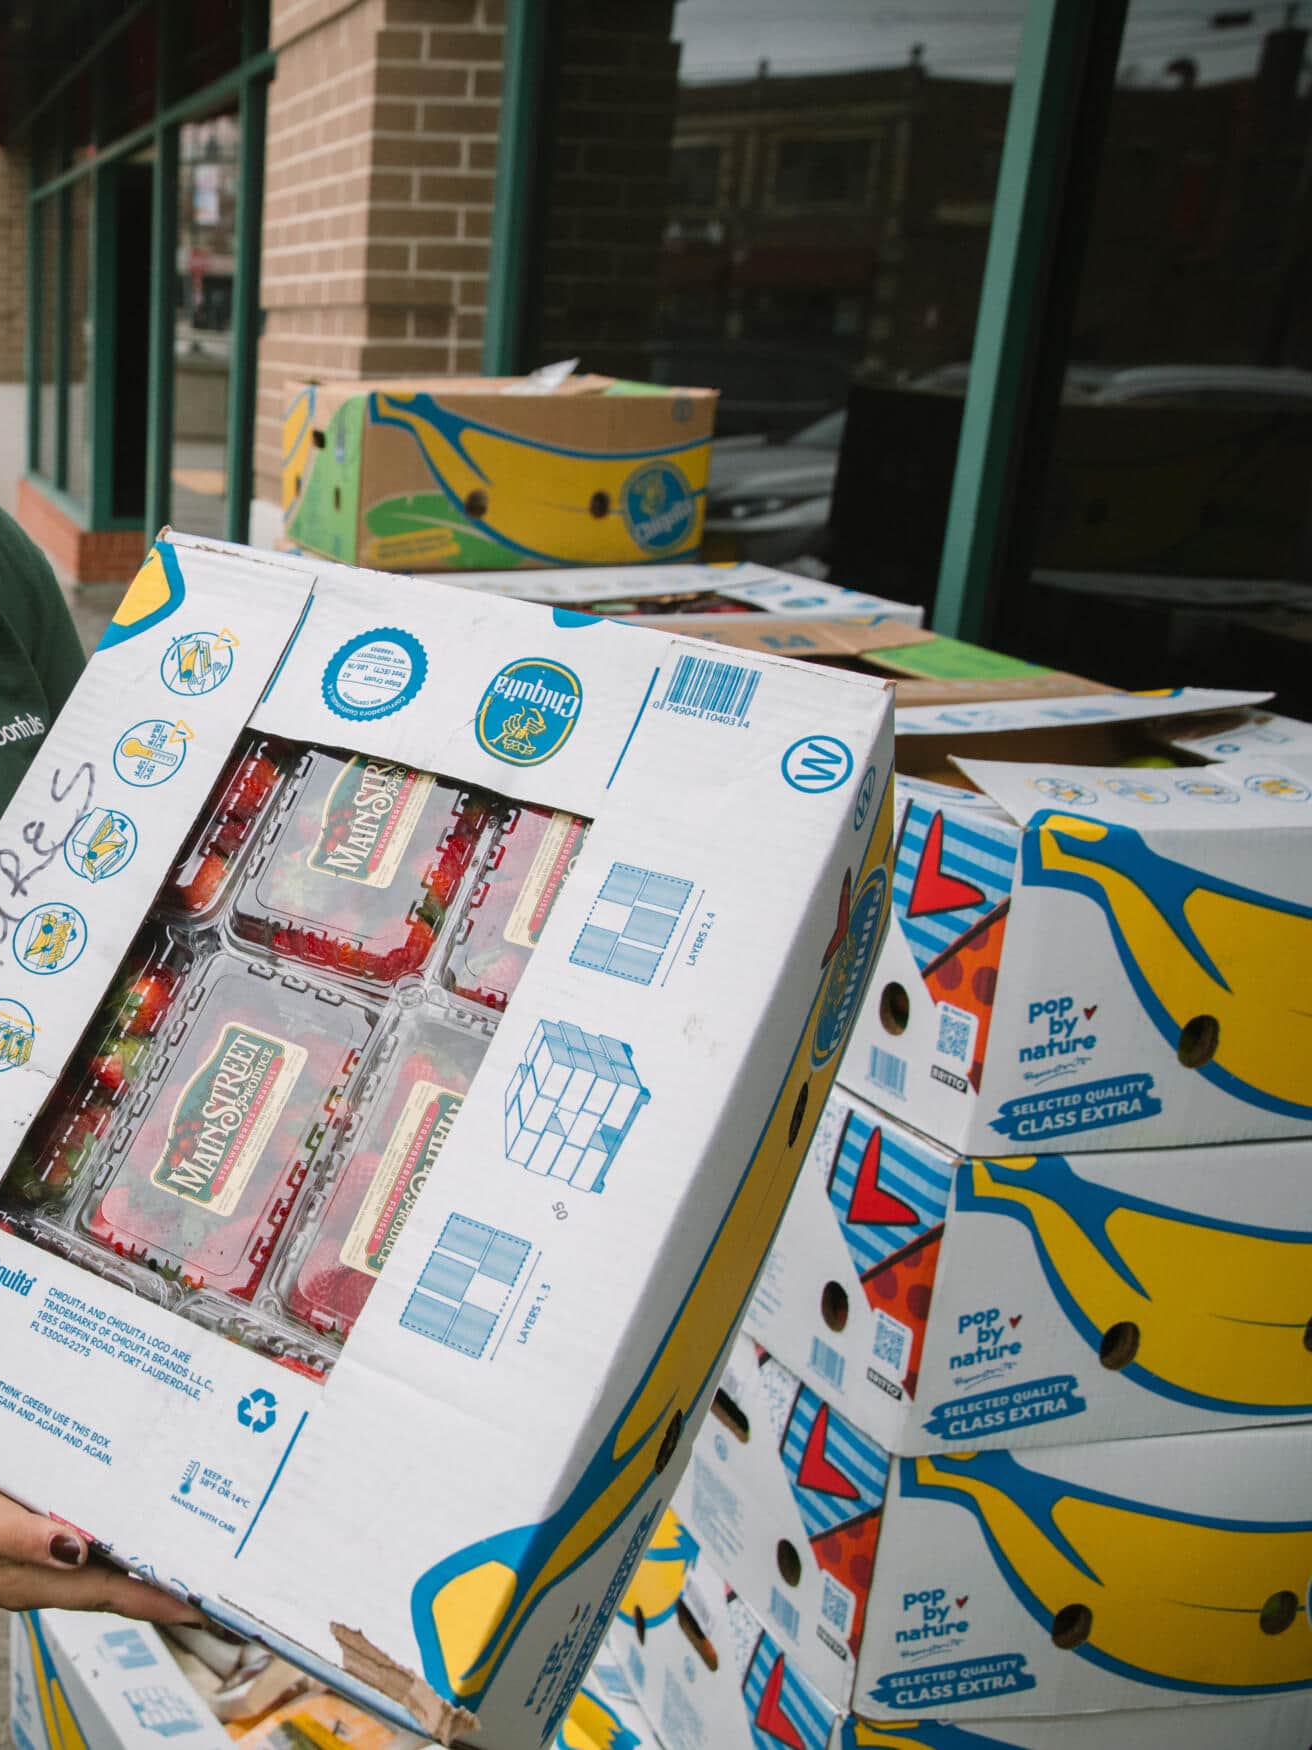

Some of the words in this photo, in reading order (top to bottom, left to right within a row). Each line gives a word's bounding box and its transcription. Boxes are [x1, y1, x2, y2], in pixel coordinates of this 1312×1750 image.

[493, 675, 580, 718] Chiquita
[666, 703, 698, 718] 74904
[704, 710, 737, 727] 10403
[794, 742, 843, 781] W
[685, 930, 709, 967] LAYERS
[1027, 996, 1074, 1025] pop
[1049, 1015, 1079, 1039] by
[1019, 1034, 1097, 1064] nature
[237, 1046, 276, 1113] PRODUCE
[1011, 1091, 1081, 1118] SELECTED
[1084, 1079, 1146, 1105] QUALITY
[1016, 1110, 1078, 1137] CLASS
[1079, 1097, 1144, 1125] EXTRA
[216, 1112, 257, 1183] STRAWBERRIES
[394, 1116, 434, 1194] STRAWBERRIES
[29, 1321, 40, 1333] FL
[40, 1326, 93, 1358] 33004-2275
[37, 1309, 60, 1327] 1855
[58, 1320, 91, 1343] GRIFFIN
[89, 1336, 116, 1358] ROAD,
[117, 1350, 143, 1369] FORT
[43, 1298, 99, 1333] TRADEMARKS
[97, 1325, 112, 1337] OF
[111, 1332, 151, 1359] CHIQUITA
[151, 1353, 189, 1379] BRANDS
[48, 1287, 87, 1312] CHIQUITA
[87, 1305, 107, 1321] AND
[106, 1315, 147, 1342] CHIQUITA
[147, 1335, 171, 1354] LOGO
[170, 1347, 192, 1364] ARE
[516, 1304, 542, 1345] LAYERS
[958, 1308, 1001, 1335] pop
[976, 1325, 1006, 1346] by
[949, 1341, 1023, 1371] nature
[943, 1394, 1009, 1419] SELECTED
[1012, 1381, 1071, 1405] QUALITY
[948, 1413, 1006, 1437] CLASS
[1008, 1398, 1069, 1422] EXTRA
[15, 1406, 36, 1423] AND
[34, 1417, 64, 1439] AGAIN
[62, 1432, 84, 1449] AND
[51, 1411, 71, 1427] USE
[70, 1420, 91, 1438] THIS
[90, 1432, 112, 1449] BOX
[202, 1467, 222, 1481] KEEP
[221, 1479, 233, 1488] AT
[217, 1486, 231, 1498] OR
[169, 1493, 199, 1514] HANDLE
[198, 1509, 220, 1525] WITH
[217, 1520, 237, 1535] CARE
[902, 1588, 947, 1612] pop
[922, 1604, 951, 1624] by
[895, 1619, 970, 1644] nature
[889, 1668, 958, 1689] SELECTED
[959, 1659, 1019, 1679] QUALITY
[894, 1686, 954, 1706] CLASS
[956, 1674, 1018, 1697] EXTRA
